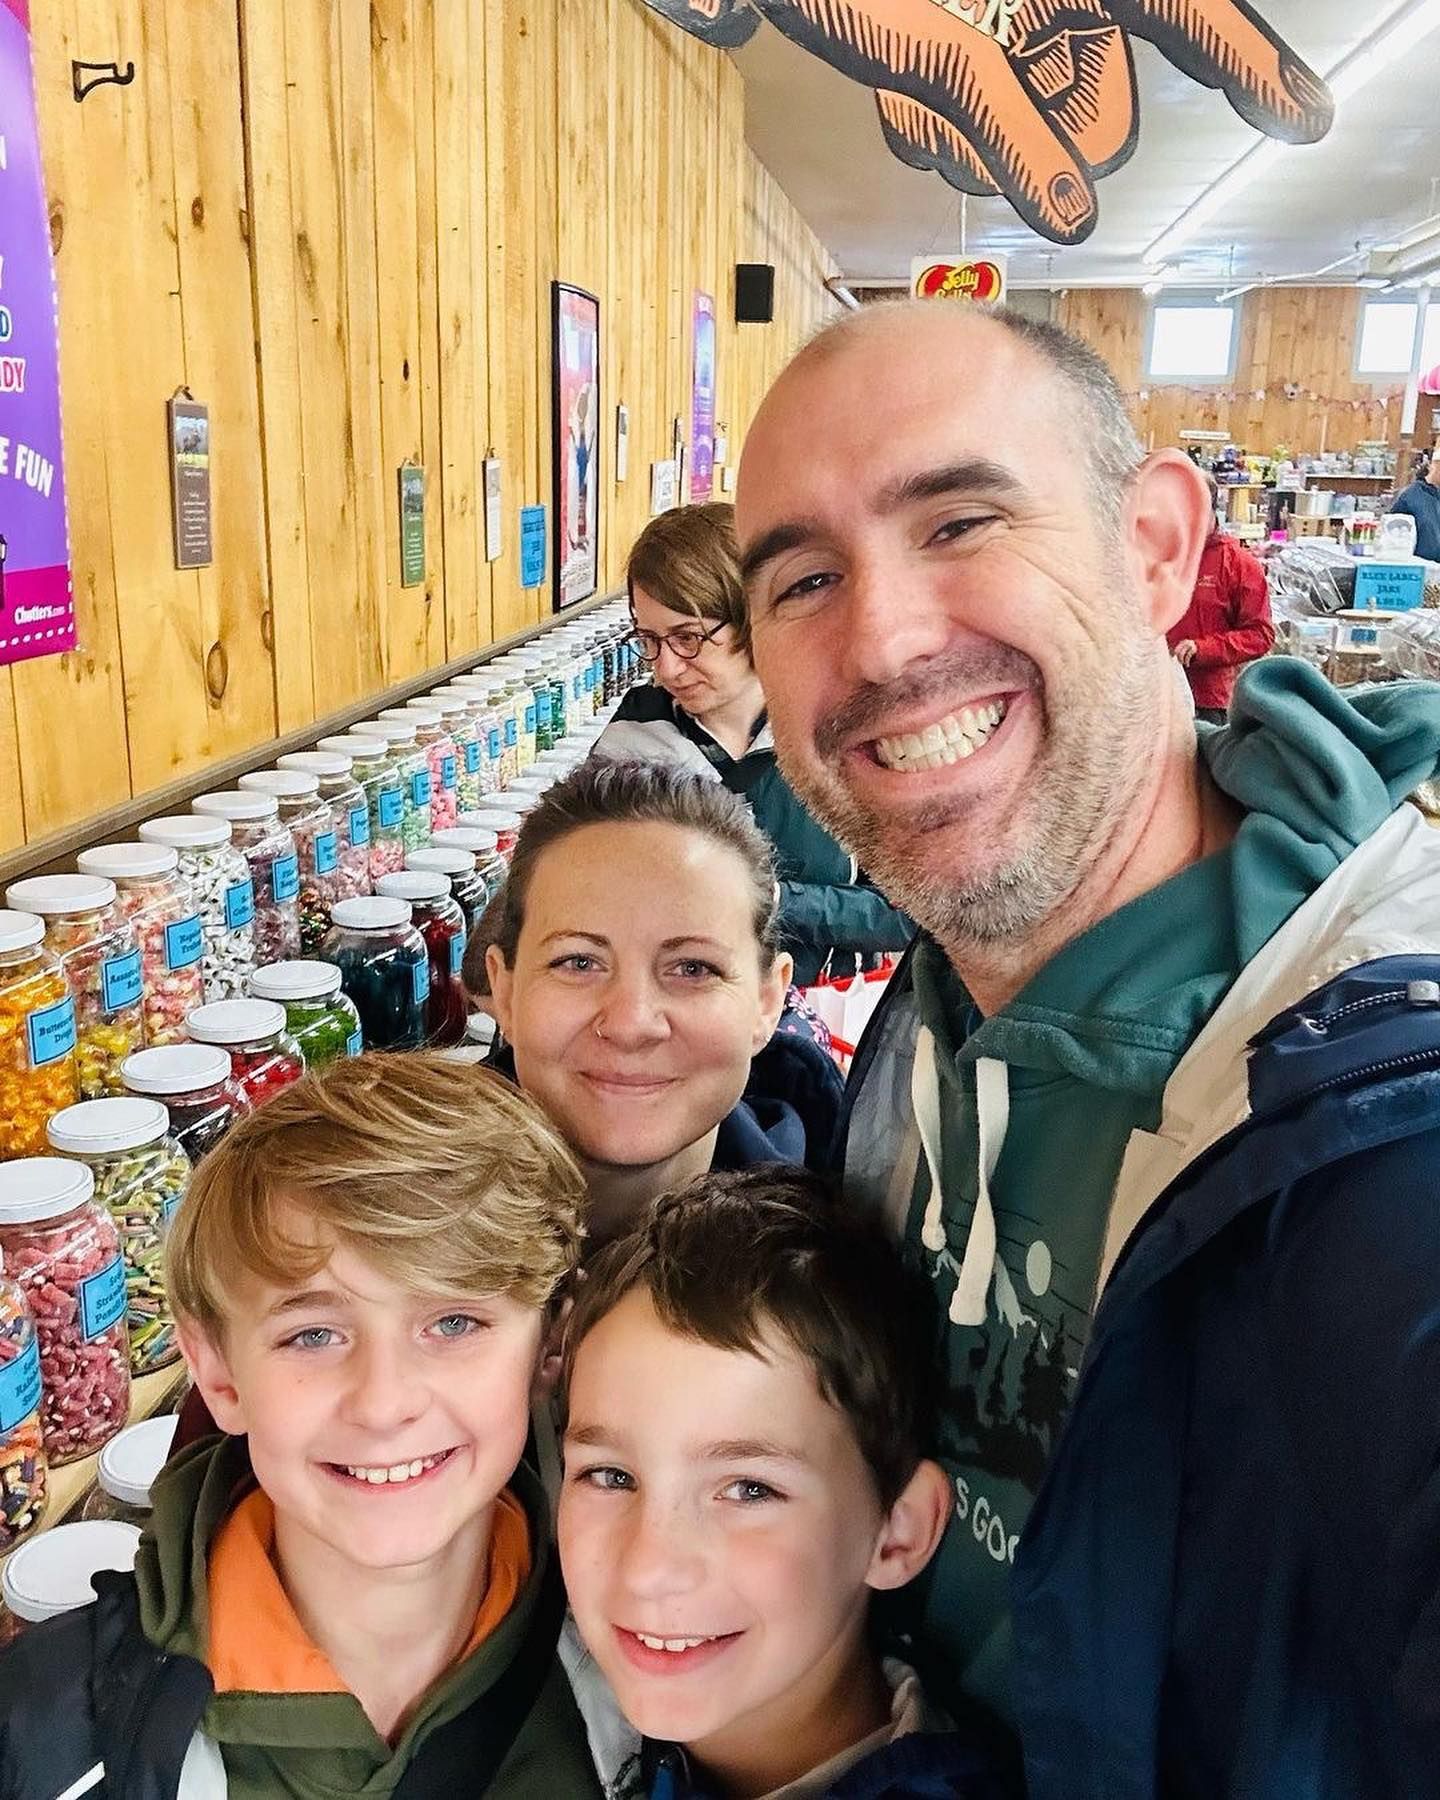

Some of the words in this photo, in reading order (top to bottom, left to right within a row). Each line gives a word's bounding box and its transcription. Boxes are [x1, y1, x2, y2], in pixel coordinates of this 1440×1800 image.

[943, 263, 979, 290] Jelly
[15, 443, 55, 498] FUN
[956, 1476, 970, 1520] S
